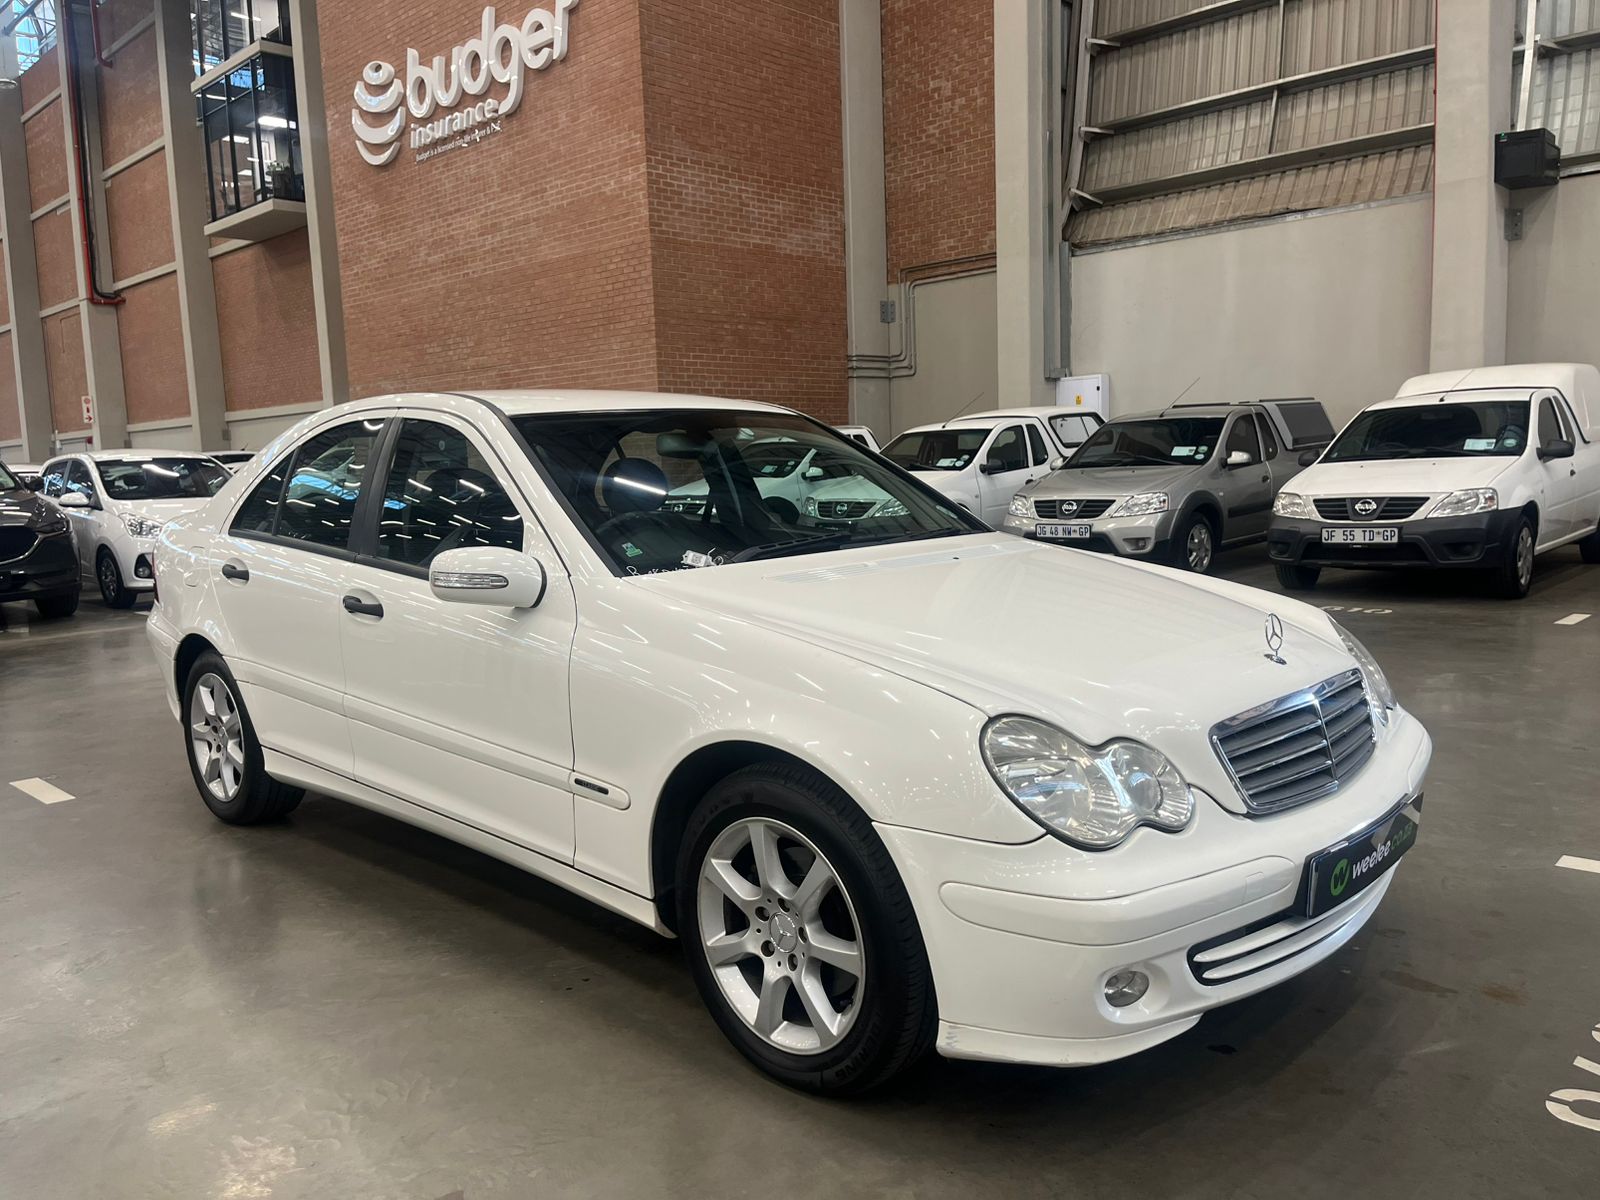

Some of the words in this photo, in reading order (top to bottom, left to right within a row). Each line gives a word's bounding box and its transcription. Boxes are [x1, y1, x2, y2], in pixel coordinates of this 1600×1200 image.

[407, 0, 579, 118] budget
[410, 98, 500, 149] insurance
[1038, 526, 1046, 536] JG
[1050, 526, 1059, 536] 48
[1062, 526, 1072, 536] NW
[1078, 526, 1089, 536] GP
[1324, 529, 1336, 541] JF
[1342, 529, 1355, 541] 55
[1361, 529, 1375, 541] TD
[1382, 529, 1396, 541] GP
